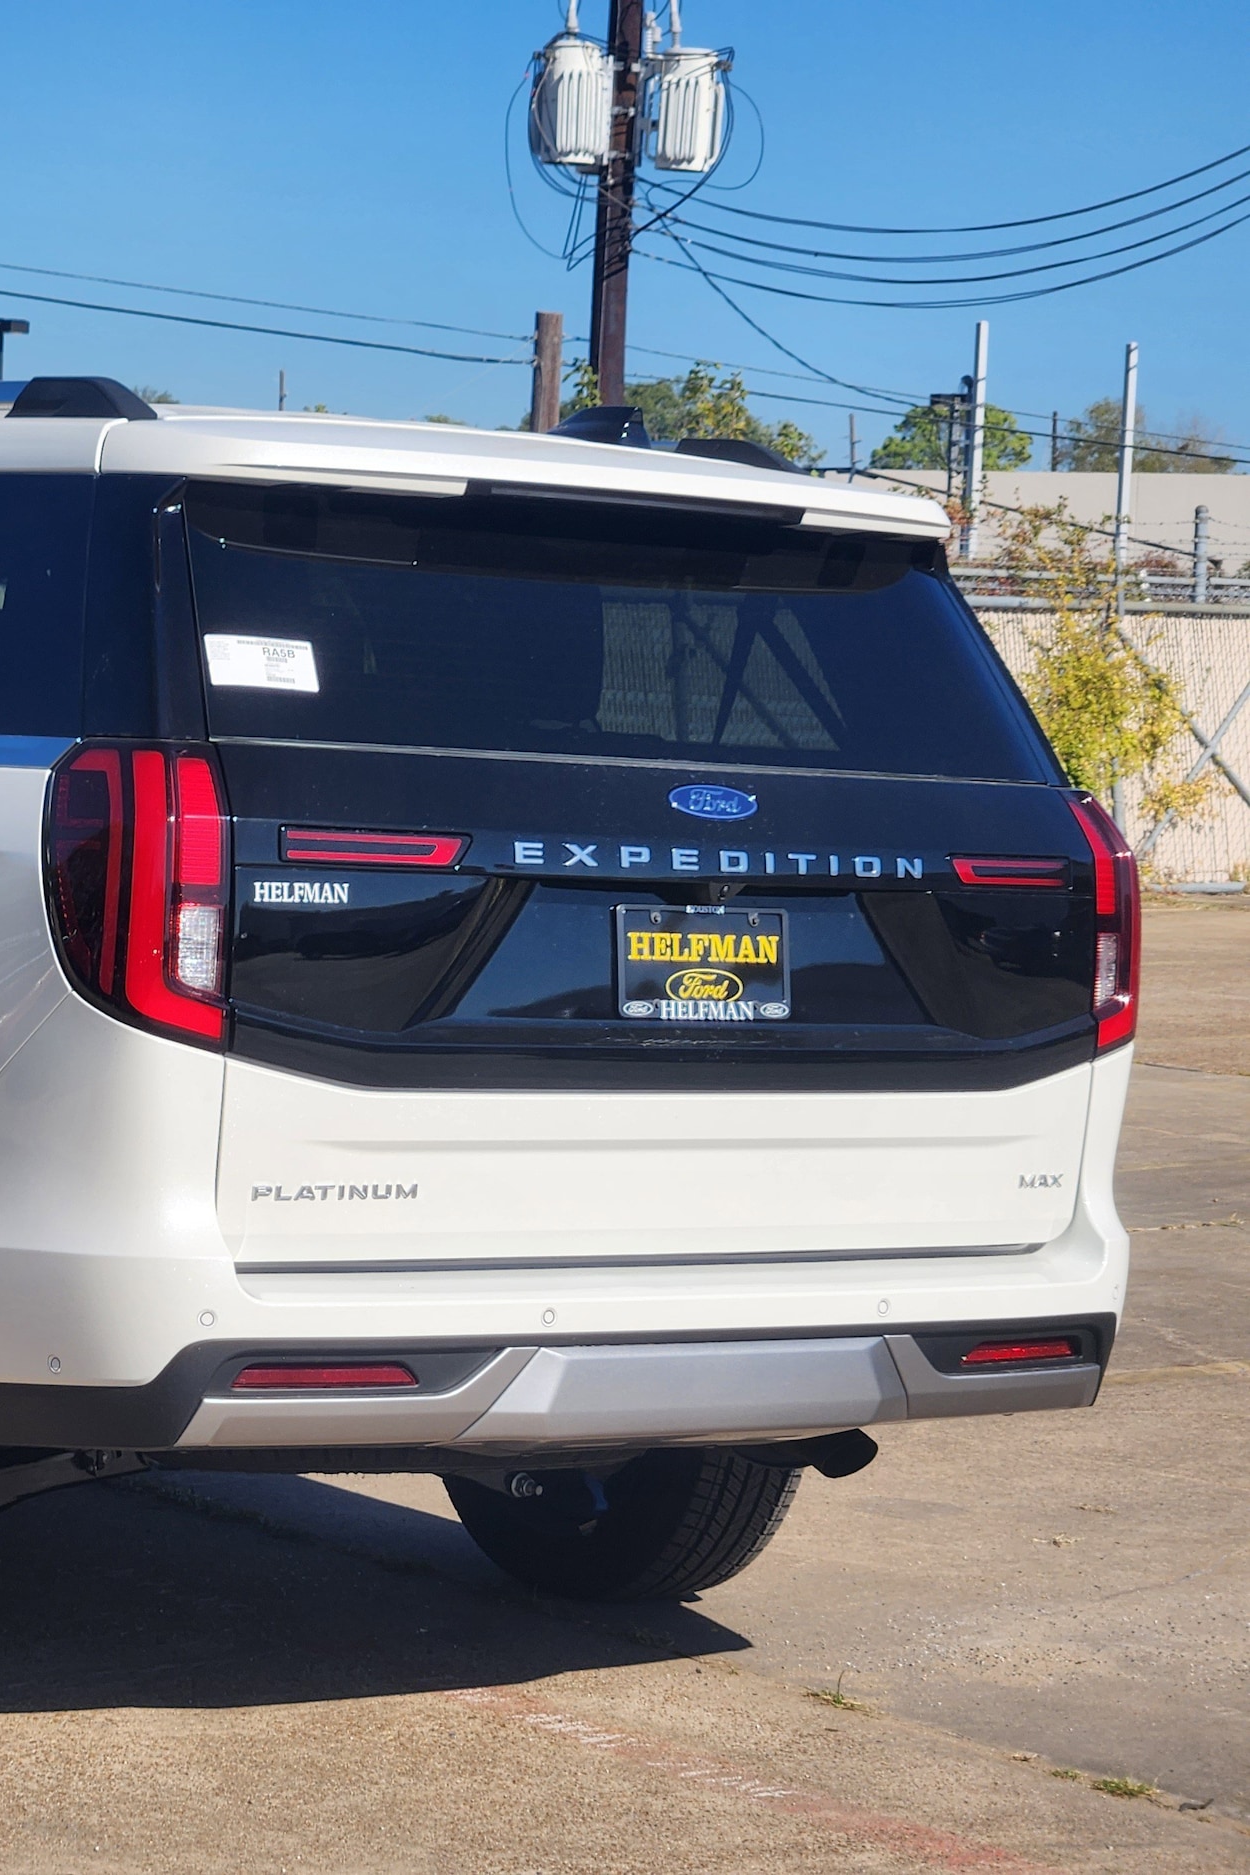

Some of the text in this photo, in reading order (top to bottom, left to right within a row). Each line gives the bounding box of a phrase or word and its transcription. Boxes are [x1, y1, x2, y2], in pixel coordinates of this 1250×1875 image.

[688, 786, 743, 814] Ford
[514, 841, 924, 880] EXPEDITION
[253, 880, 350, 904] HELFMAN
[627, 931, 780, 965] HELFMAN
[678, 972, 730, 1000] Ford
[659, 1000, 756, 1021] HELFMAN
[250, 1183, 419, 1202] PLATINUM
[1017, 1173, 1064, 1189] MAX
